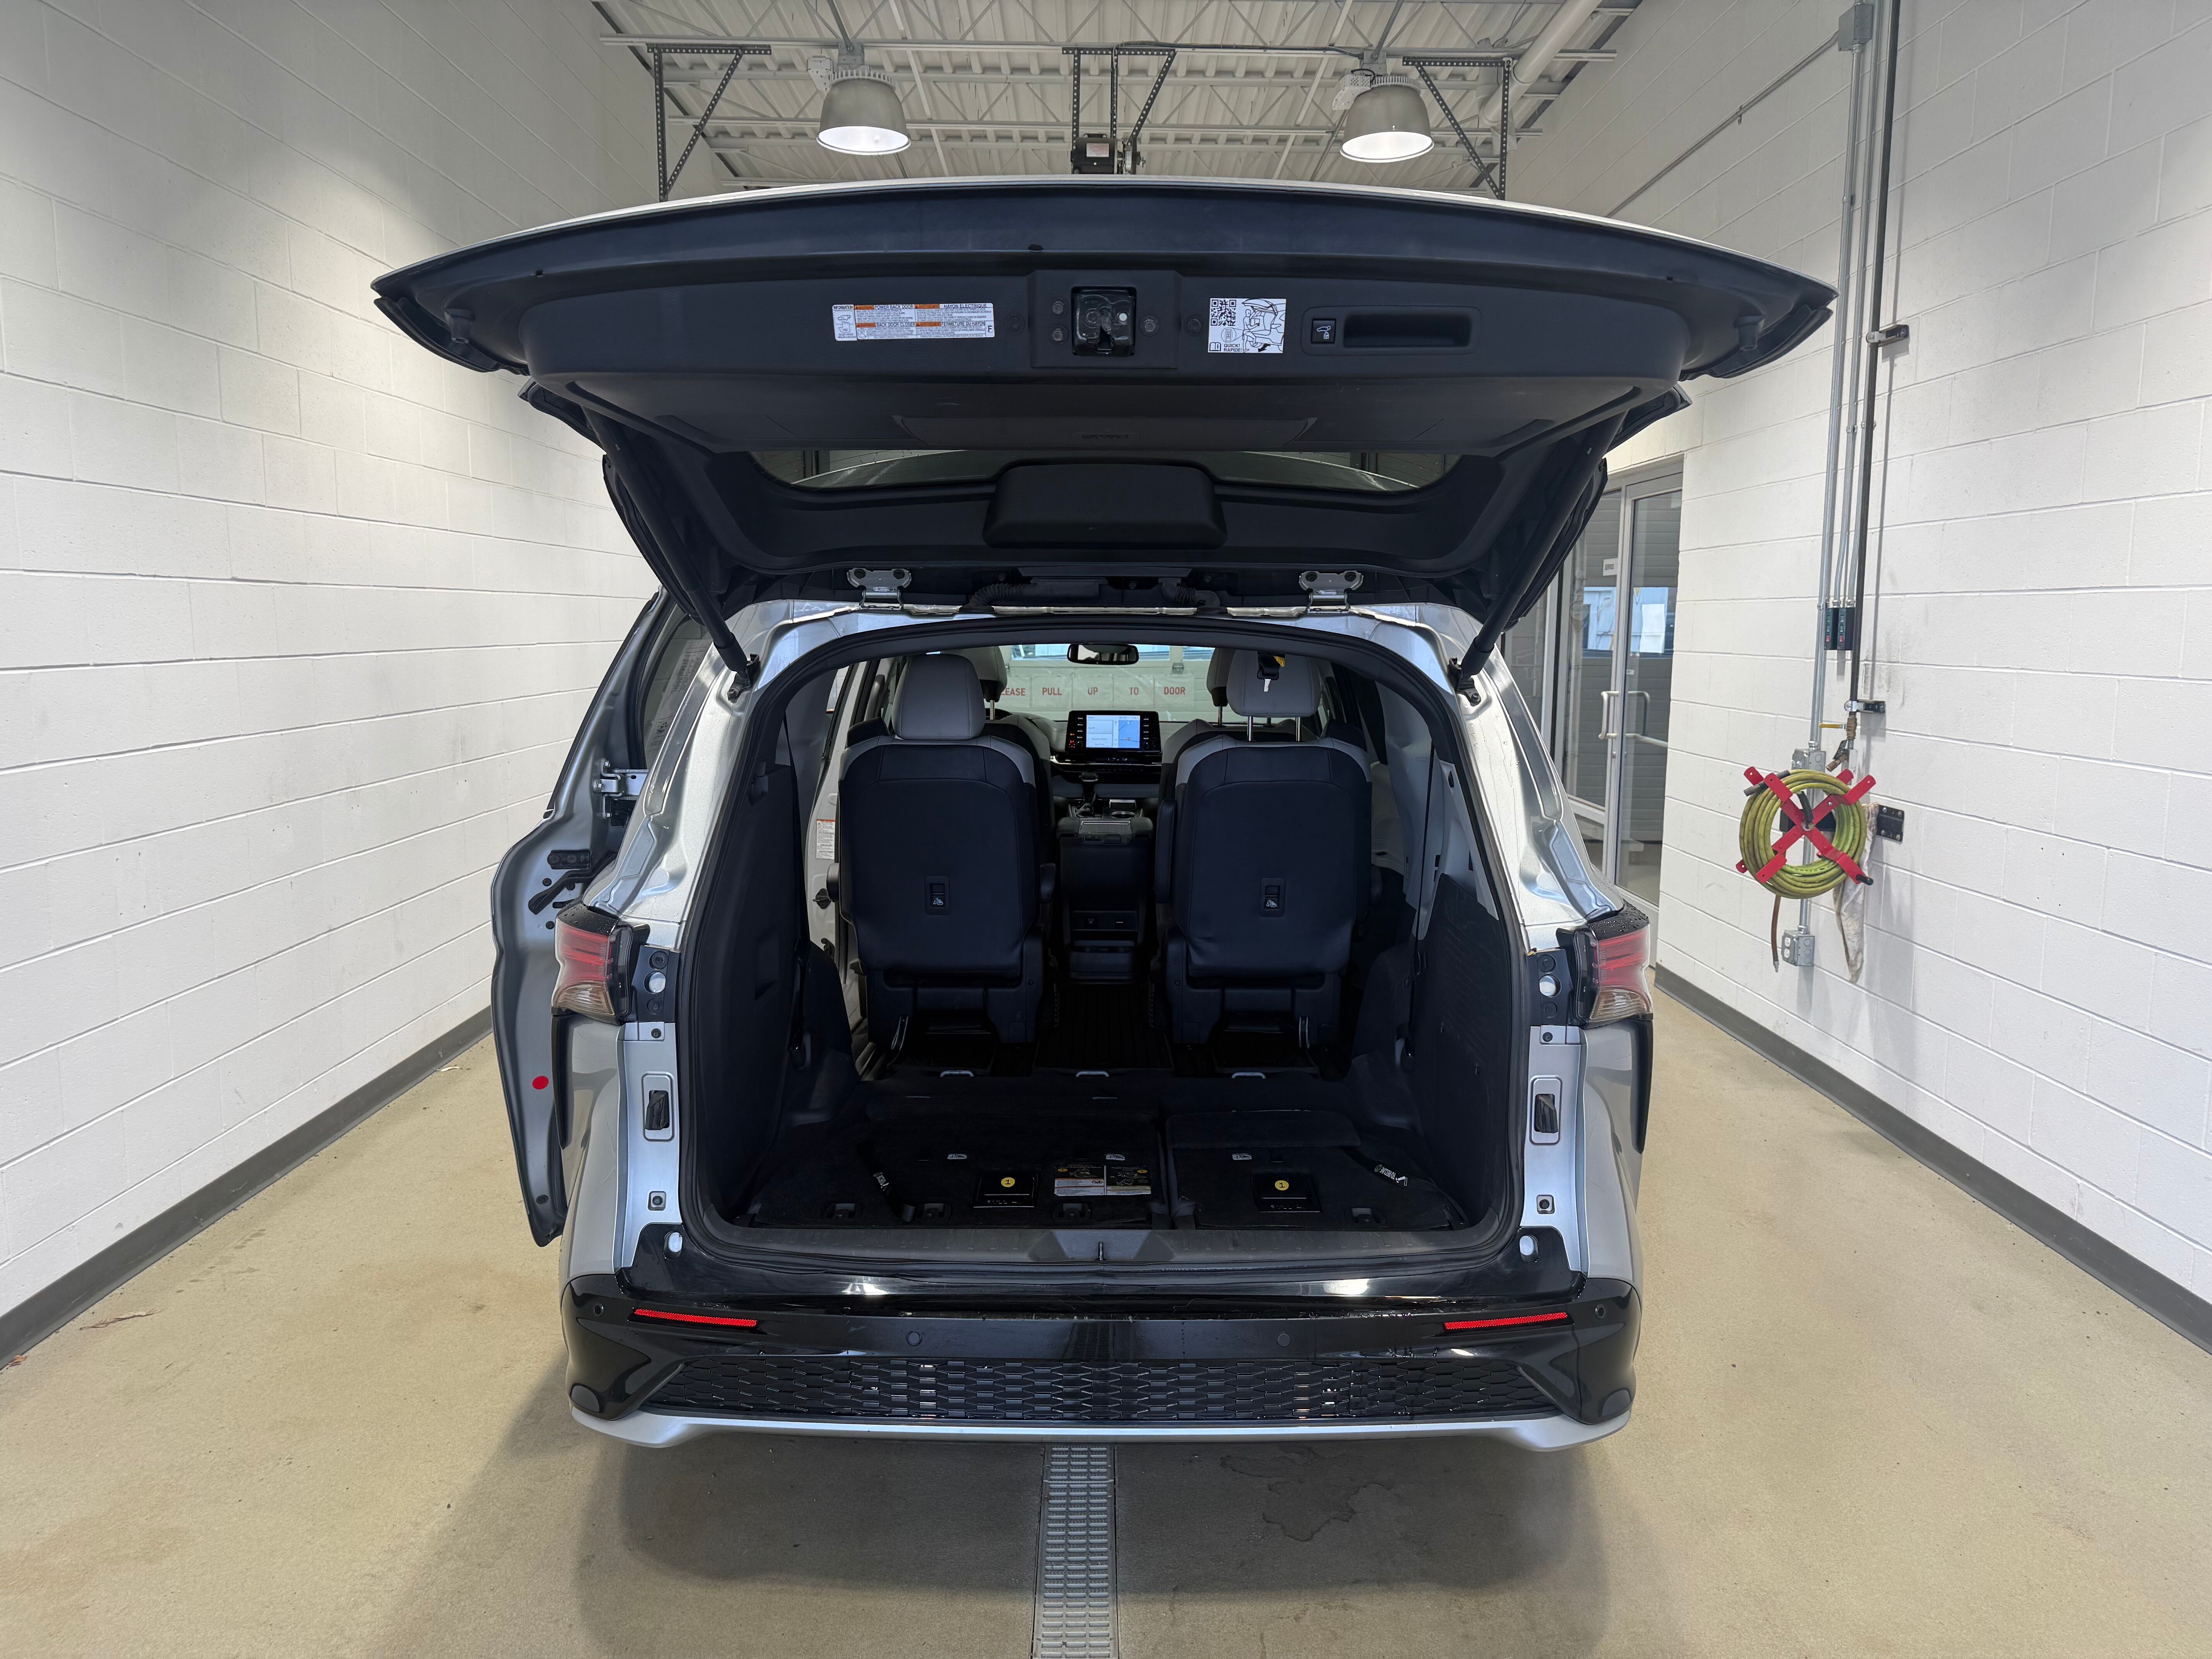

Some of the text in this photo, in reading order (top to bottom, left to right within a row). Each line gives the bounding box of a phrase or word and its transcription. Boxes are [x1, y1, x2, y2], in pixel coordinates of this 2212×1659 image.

[1042, 687, 1062, 696] PULL
[1087, 687, 1098, 695] UP
[1129, 687, 1139, 695] TO
[1164, 687, 1185, 695] DOOR
